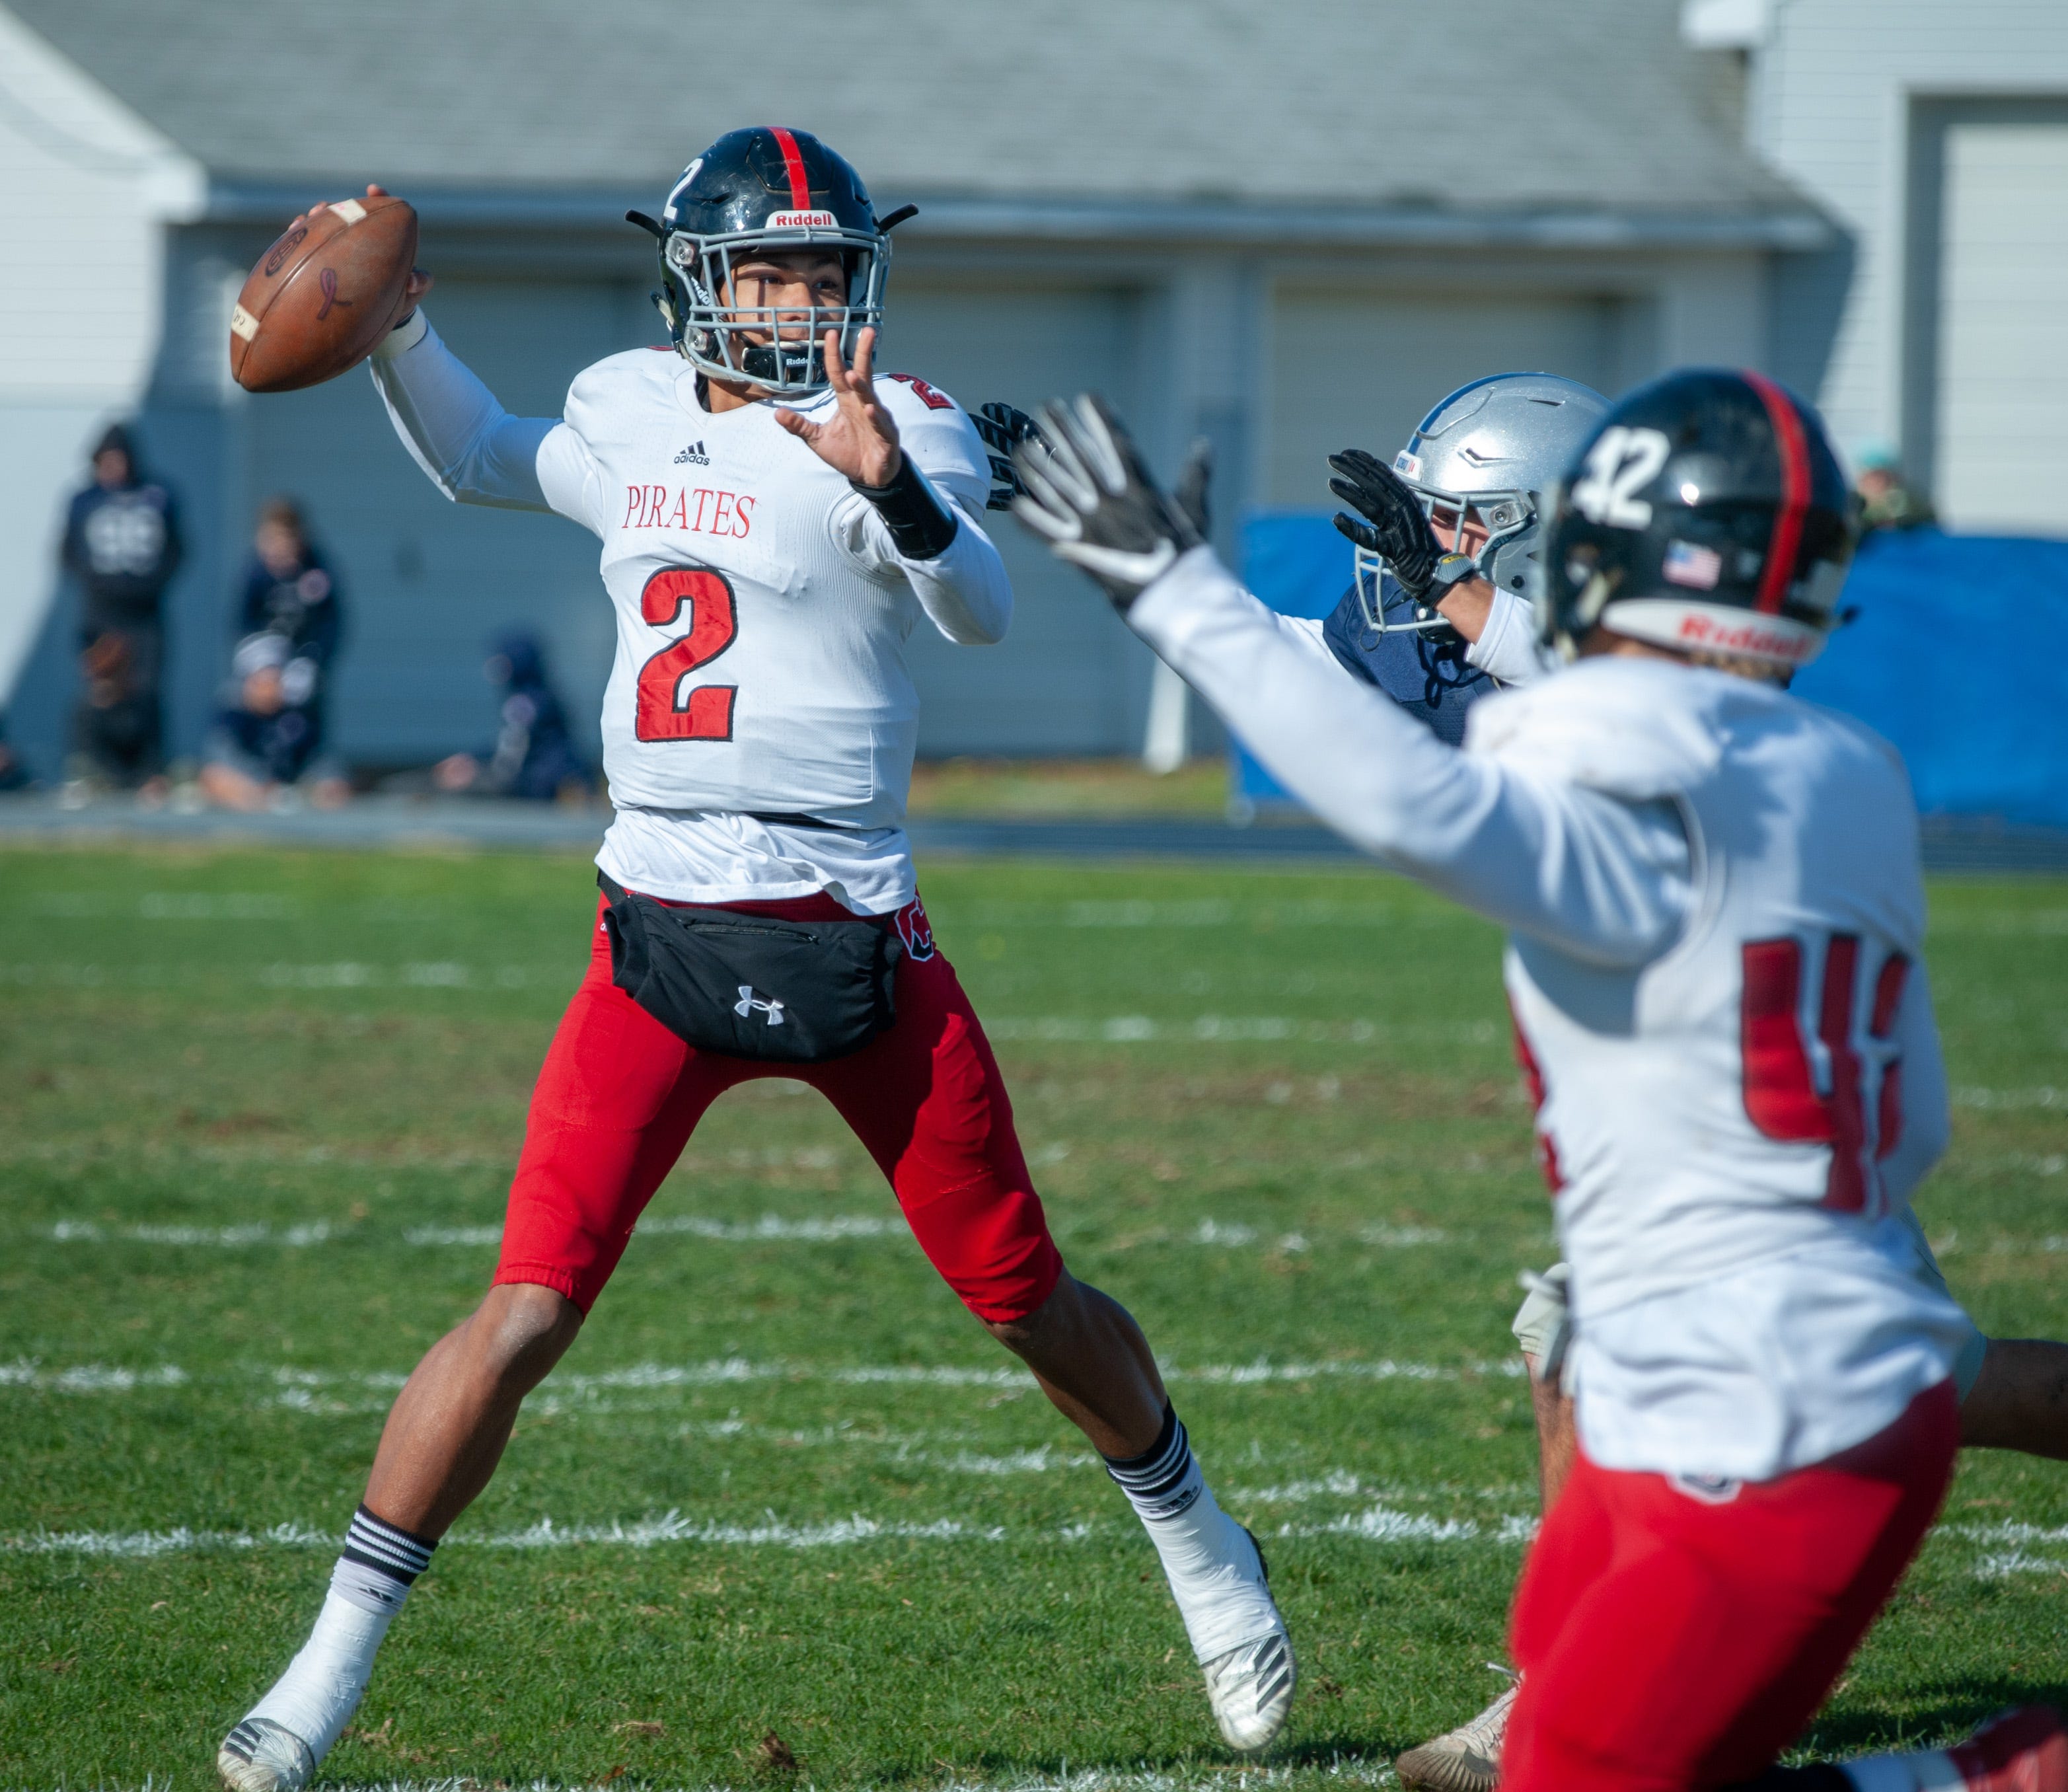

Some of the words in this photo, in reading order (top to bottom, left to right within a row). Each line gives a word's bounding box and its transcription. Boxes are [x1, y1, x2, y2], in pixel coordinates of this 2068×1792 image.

[663, 157, 704, 221] 2
[776, 213, 832, 226] Riddell
[887, 373, 956, 410] 2
[673, 453, 710, 466] adidas
[1570, 425, 1670, 531] 42
[622, 484, 757, 539] PIRATES
[634, 564, 739, 743] 2
